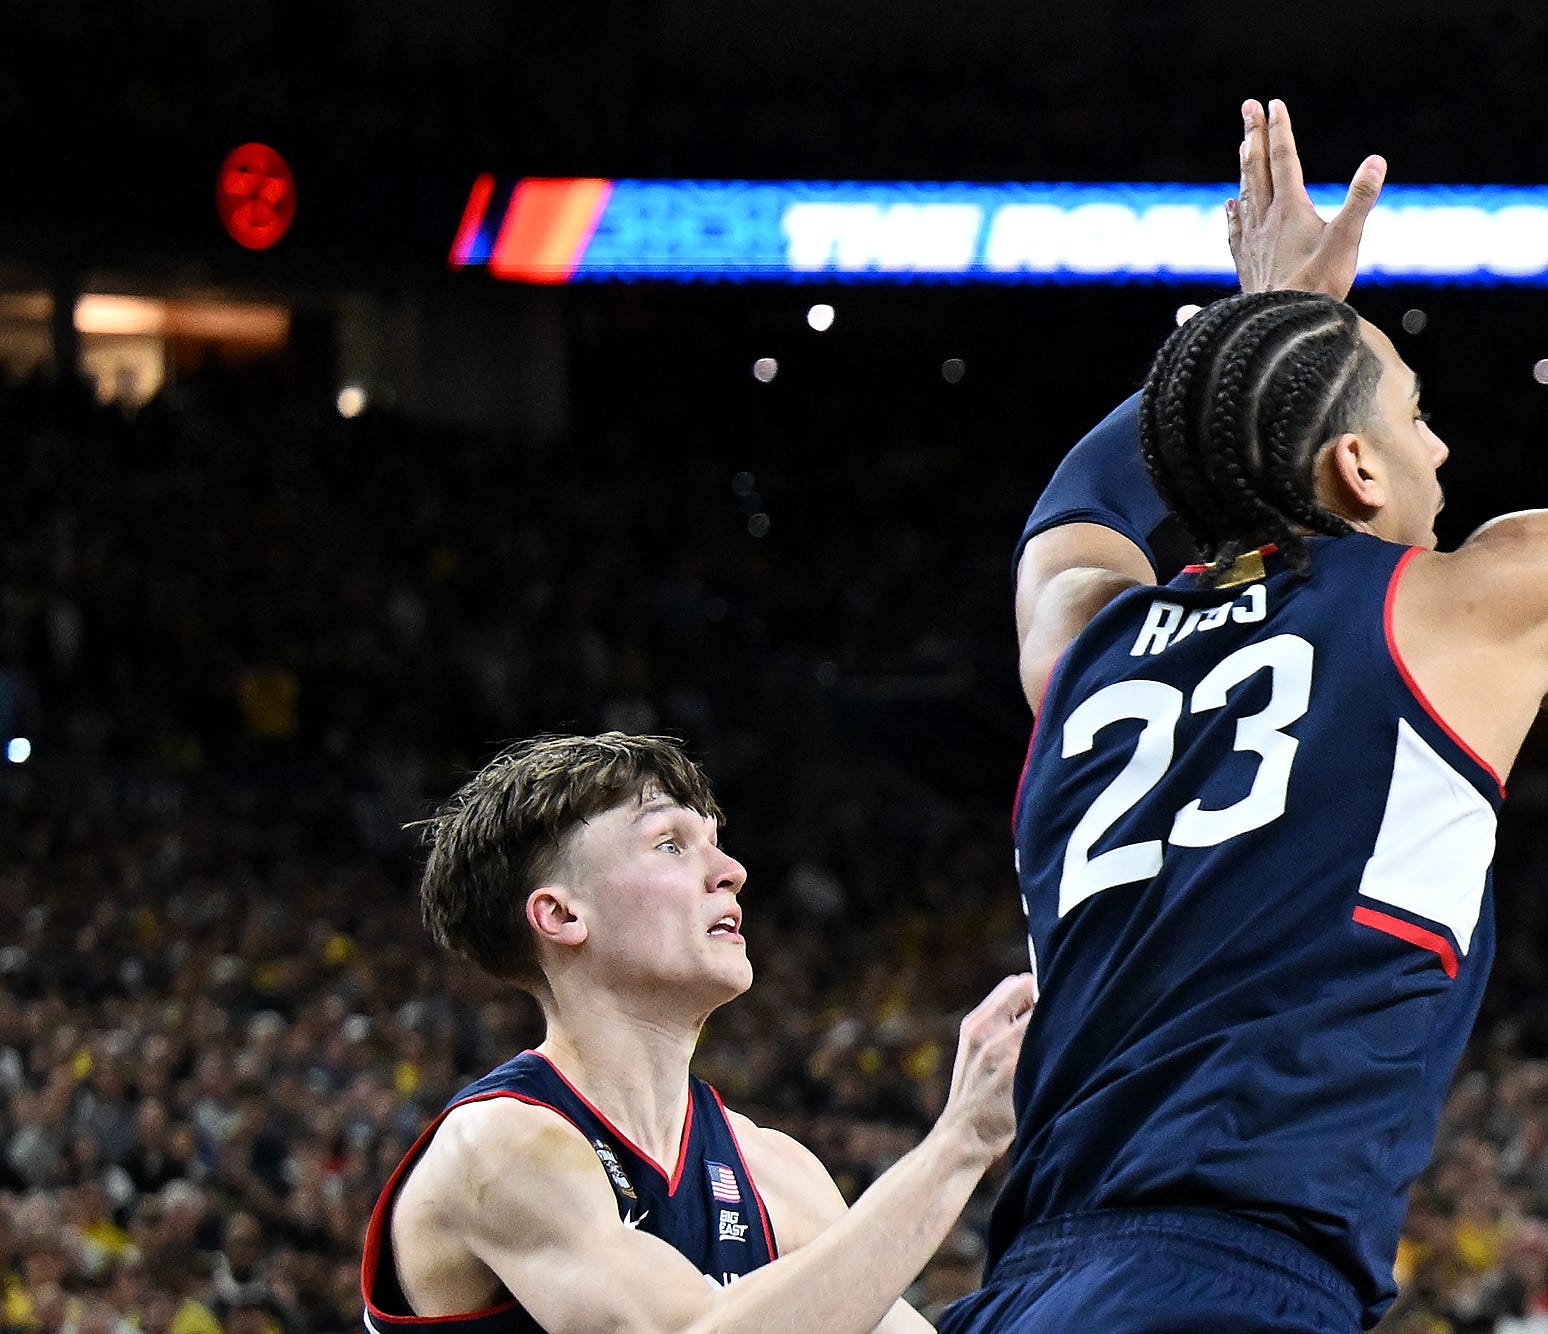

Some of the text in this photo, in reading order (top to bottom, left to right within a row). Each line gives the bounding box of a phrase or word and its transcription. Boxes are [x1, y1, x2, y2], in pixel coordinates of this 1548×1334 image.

[1058, 633, 1315, 919] 23
[719, 1209, 741, 1224] BIG
[718, 1223, 749, 1238] EAST
